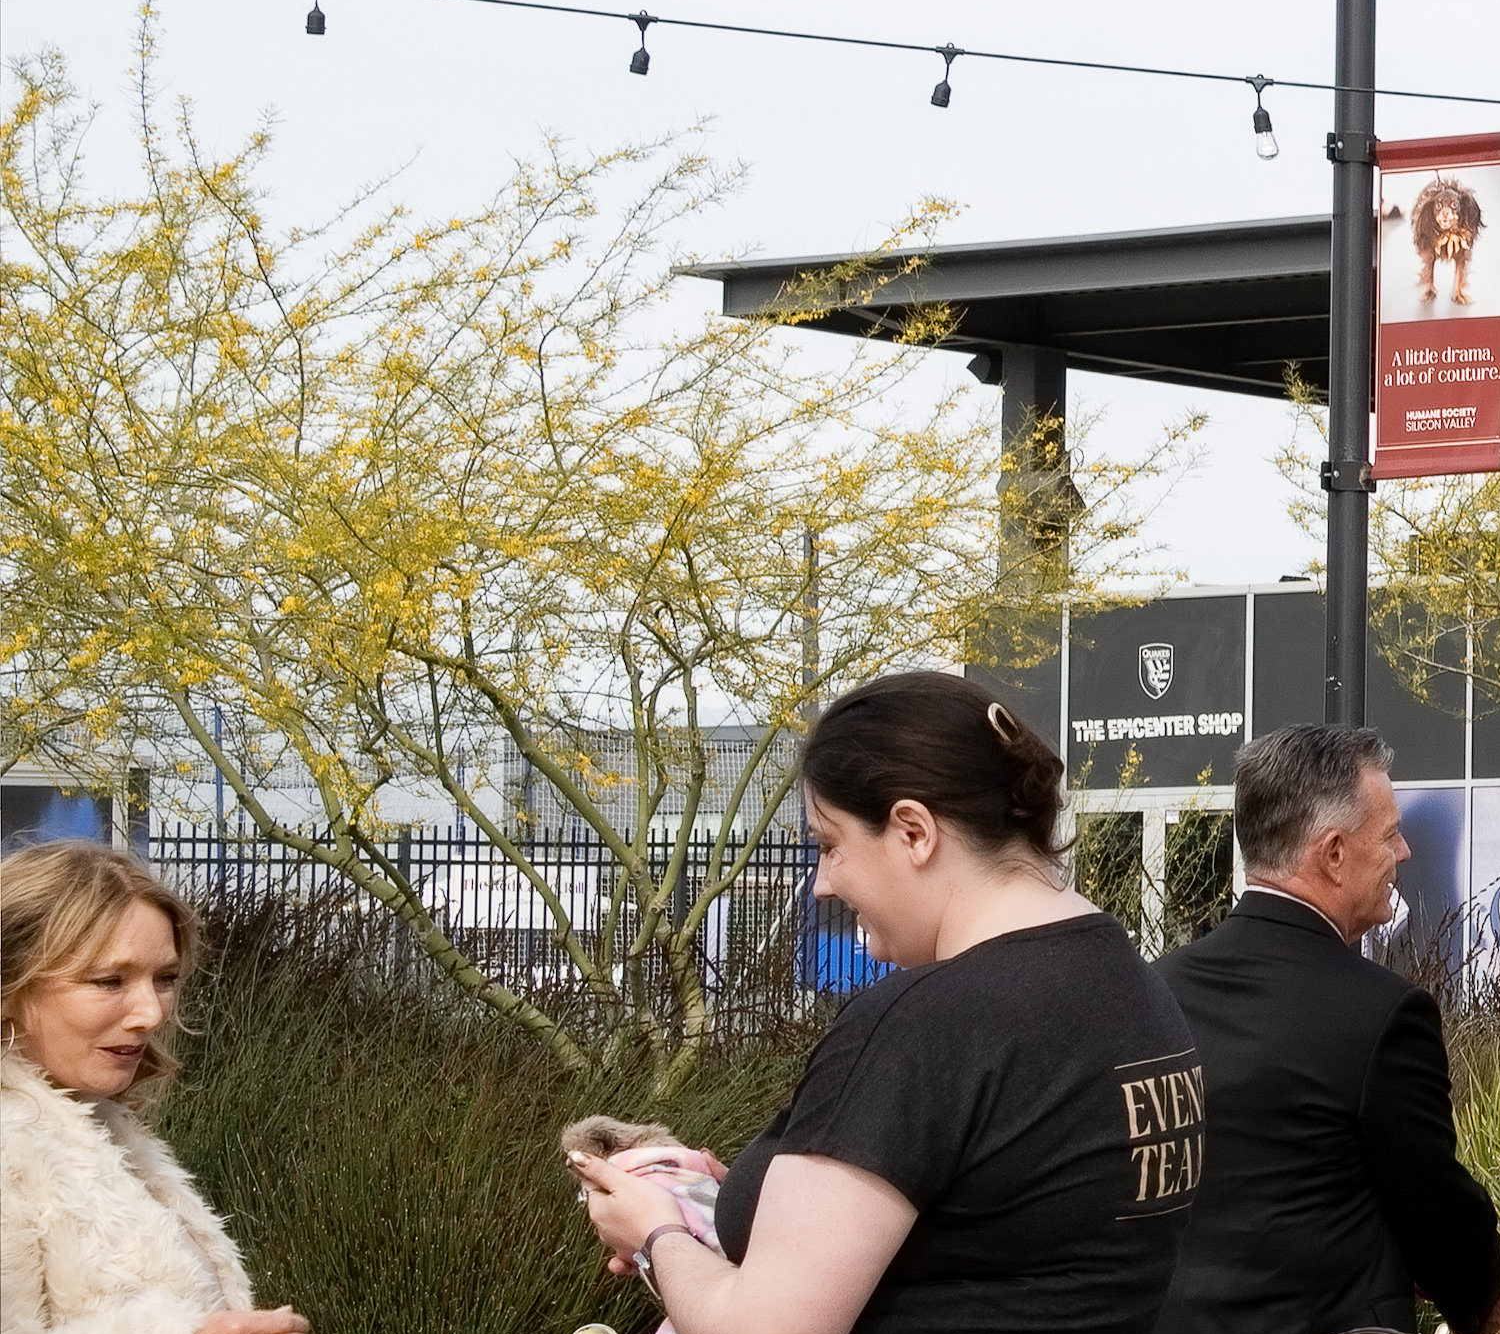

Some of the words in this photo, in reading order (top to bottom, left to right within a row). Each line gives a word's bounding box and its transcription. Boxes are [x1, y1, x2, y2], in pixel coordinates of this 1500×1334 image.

[1391, 350, 1402, 367] A
[1405, 347, 1439, 366] little
[1441, 346, 1495, 363] drama,
[1384, 373, 1393, 387] a
[1396, 369, 1416, 386] lot
[1418, 367, 1436, 384] of
[1405, 409, 1441, 421] HUMANE
[1441, 406, 1477, 418] SOCIETY
[1405, 419, 1441, 432] SILICON
[1442, 417, 1476, 429] VALLEY
[1072, 718, 1106, 742] THE
[1107, 715, 1195, 740] EPICENTER
[1197, 712, 1243, 736] SHOP
